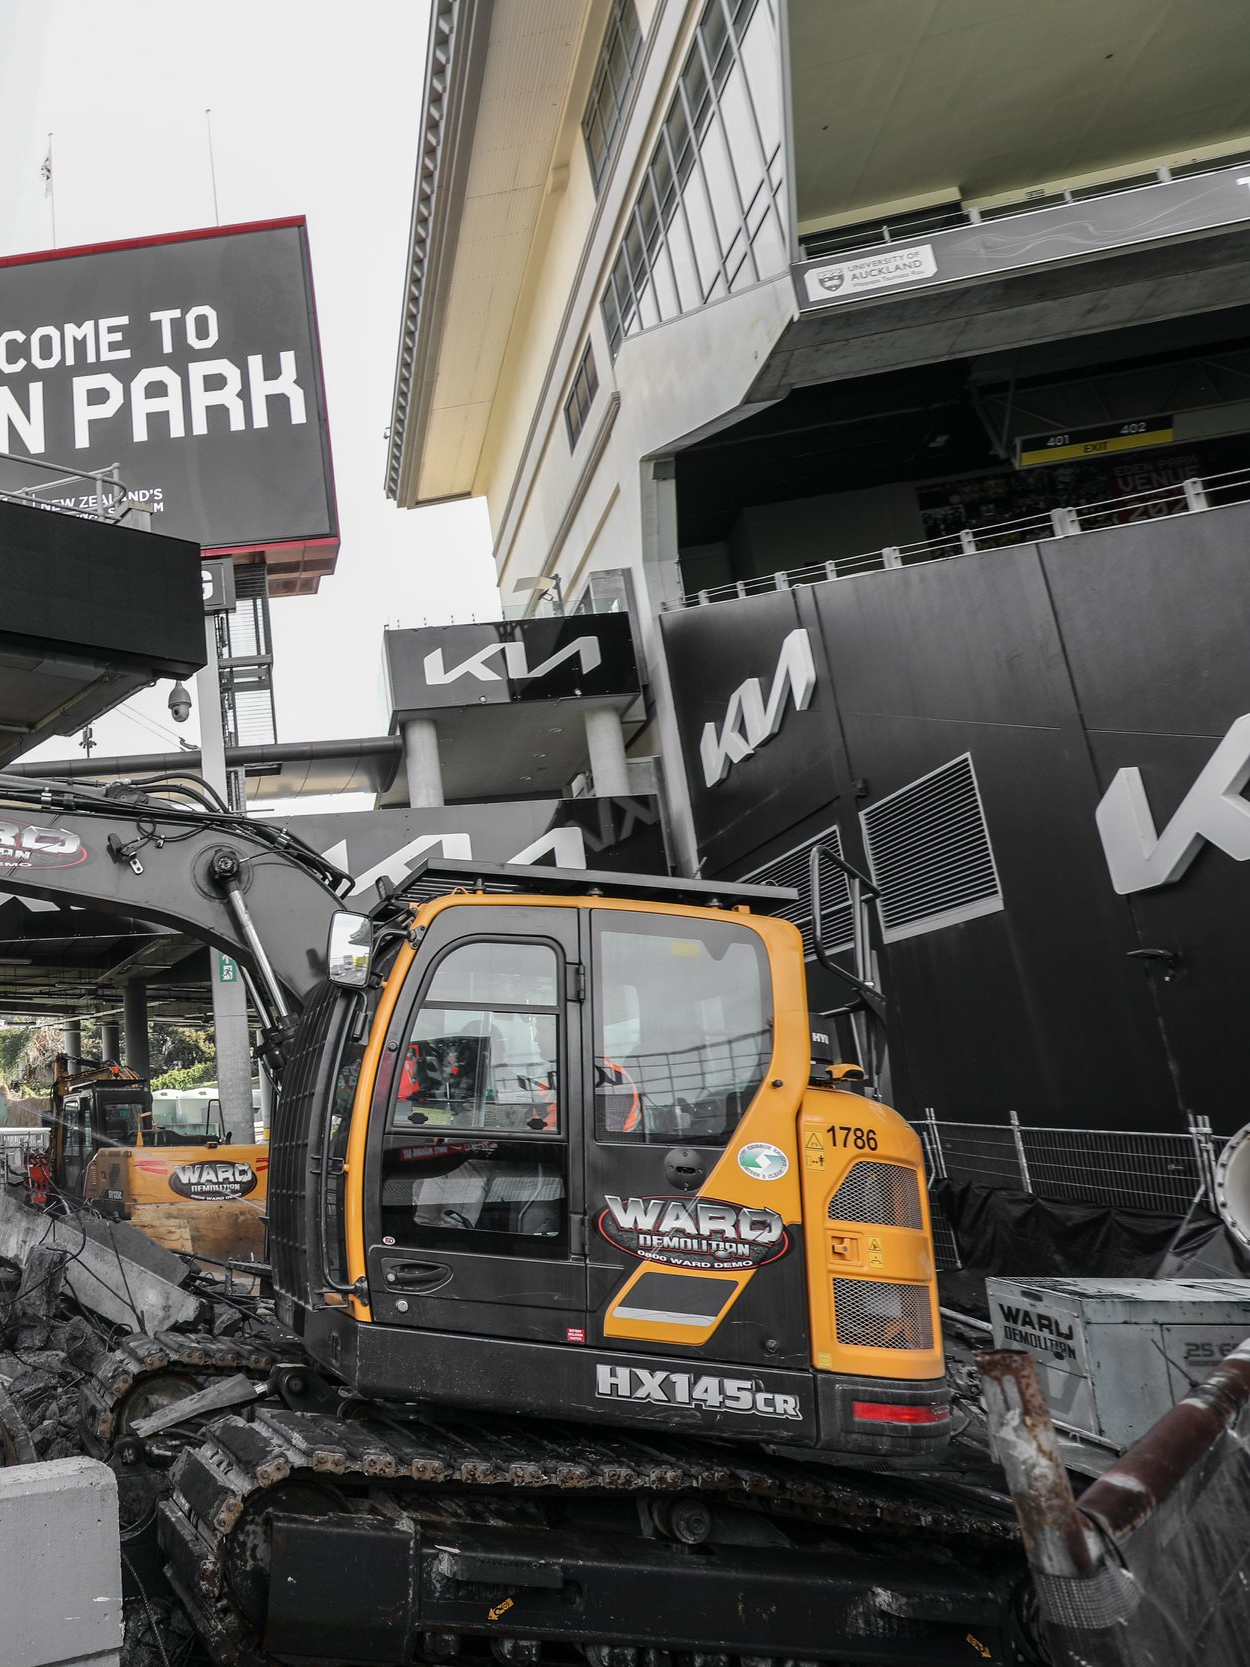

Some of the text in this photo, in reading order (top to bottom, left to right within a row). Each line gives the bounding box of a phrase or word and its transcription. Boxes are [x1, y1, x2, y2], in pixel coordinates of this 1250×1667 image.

[847, 251, 919, 271] UNIVERSITY OF
[850, 260, 923, 281] AUCKLAND
[150, 305, 219, 354] TO
[73, 351, 307, 449] PARK
[1120, 422, 1148, 434] 402
[1047, 434, 1070, 446] 401
[1083, 441, 1109, 454] EXIT
[79, 488, 163, 508] ZEALND'S
[826, 1125, 878, 1151] 1786
[173, 1163, 252, 1184] WARD
[191, 1183, 240, 1193] DEMOLITION
[604, 1195, 784, 1243] WARD
[639, 1234, 750, 1258] DEMOLITION
[637, 1249, 753, 1268] 0800 WARD DEMO
[998, 1303, 1074, 1341] WARD
[1004, 1325, 1077, 1360] DEMOLITION
[595, 1364, 800, 1416] HX145CR
